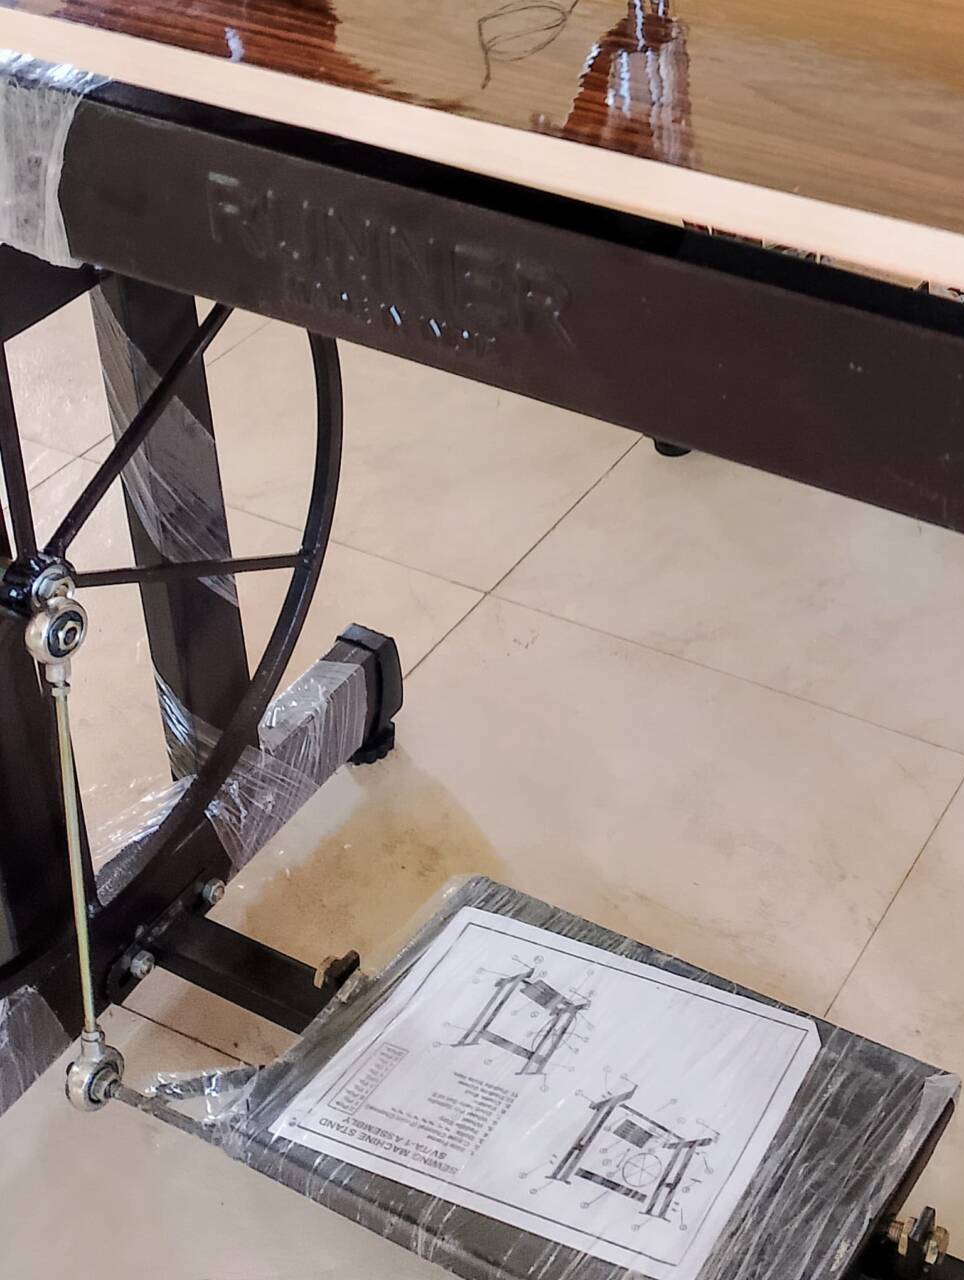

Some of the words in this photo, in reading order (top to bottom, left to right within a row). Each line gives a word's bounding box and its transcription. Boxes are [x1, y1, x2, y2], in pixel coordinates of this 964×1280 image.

[318, 1117, 355, 1136] STAND
[341, 1116, 403, 1143] ASSEMBLY
[357, 1132, 411, 1158] MACHINE
[412, 1152, 459, 1174] SEWING
